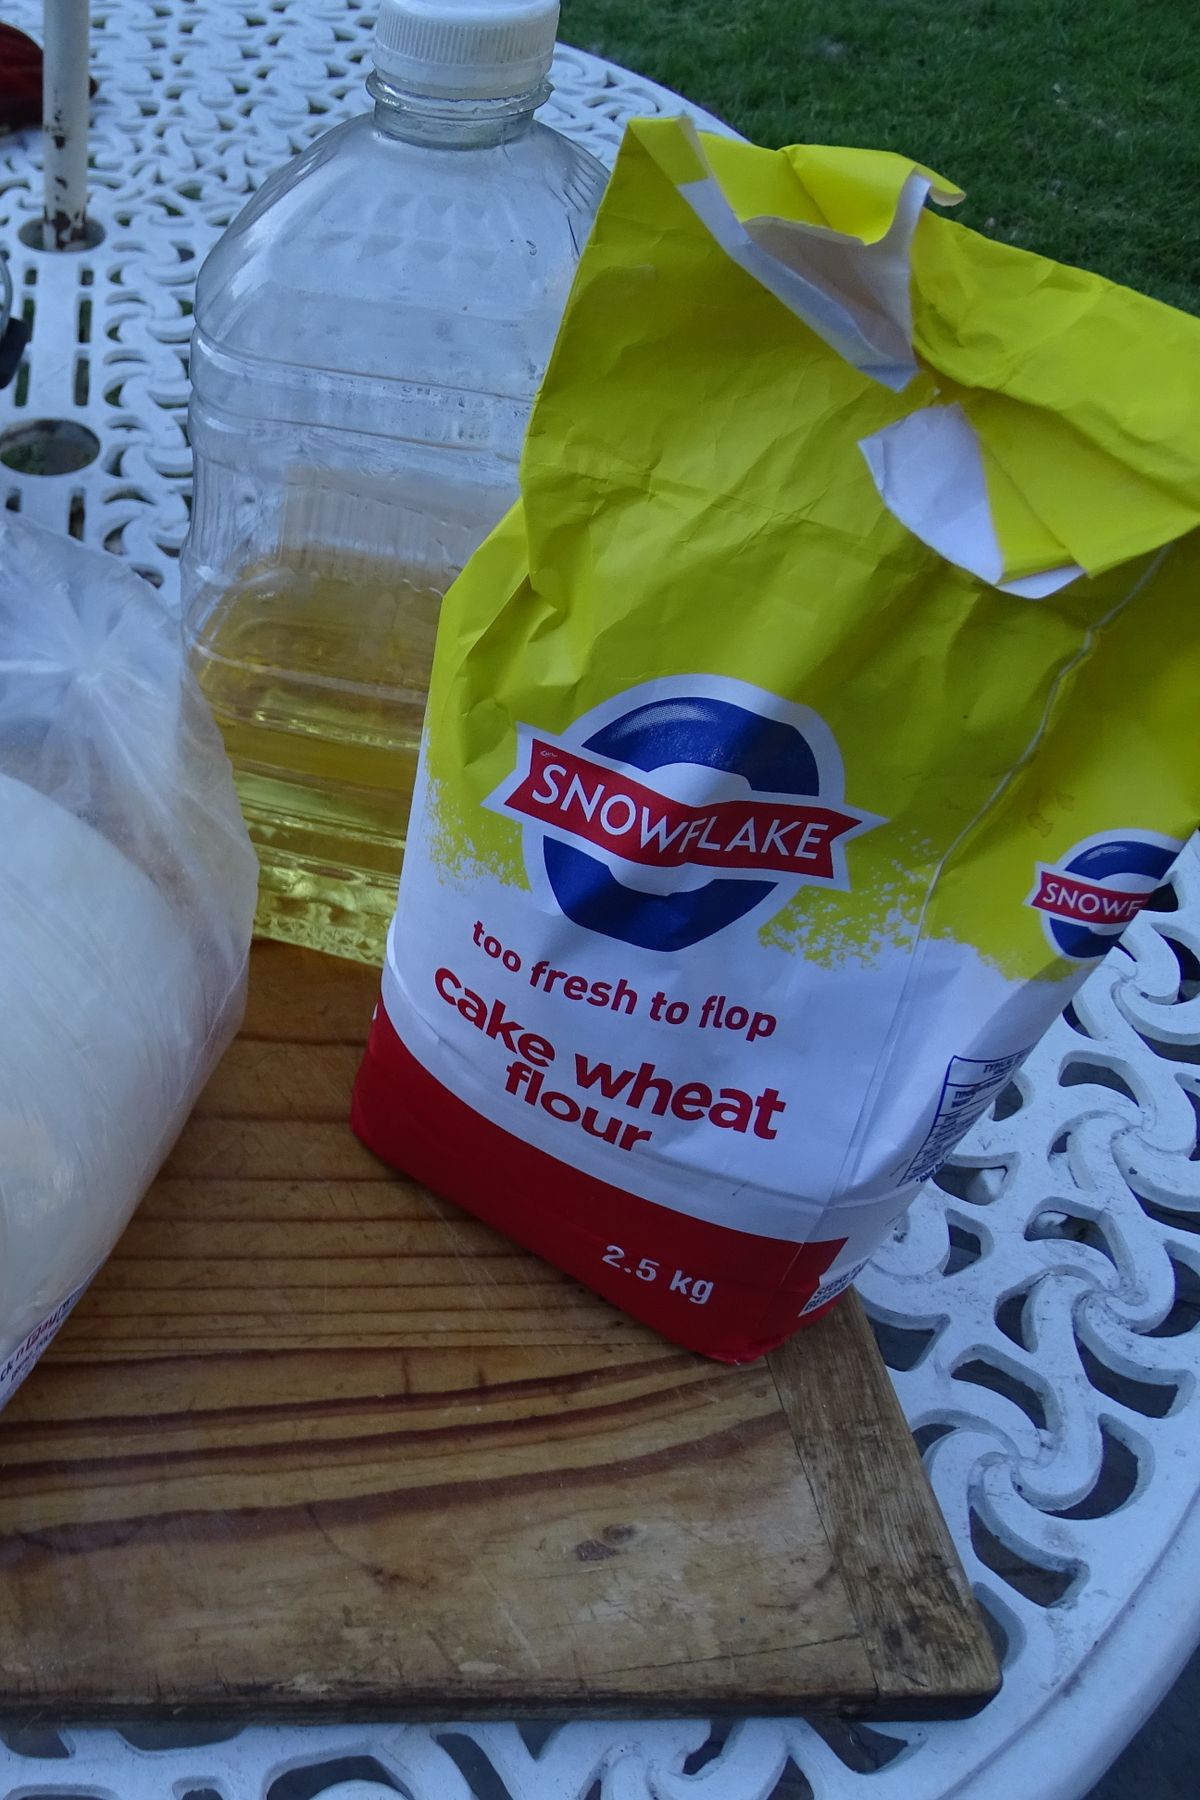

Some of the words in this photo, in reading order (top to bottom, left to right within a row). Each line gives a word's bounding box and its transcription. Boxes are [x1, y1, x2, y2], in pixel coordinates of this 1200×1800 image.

[531, 763, 830, 860] SNOWFLAKE
[472, 920, 522, 973] too
[530, 960, 638, 1015] fresh
[649, 992, 690, 1026] to
[698, 995, 777, 1042] flop
[434, 967, 556, 1068] cake
[574, 1053, 787, 1140] wheat
[504, 1060, 653, 1152] flour
[601, 1244, 660, 1283] 2.5
[669, 1268, 714, 1305] kg
